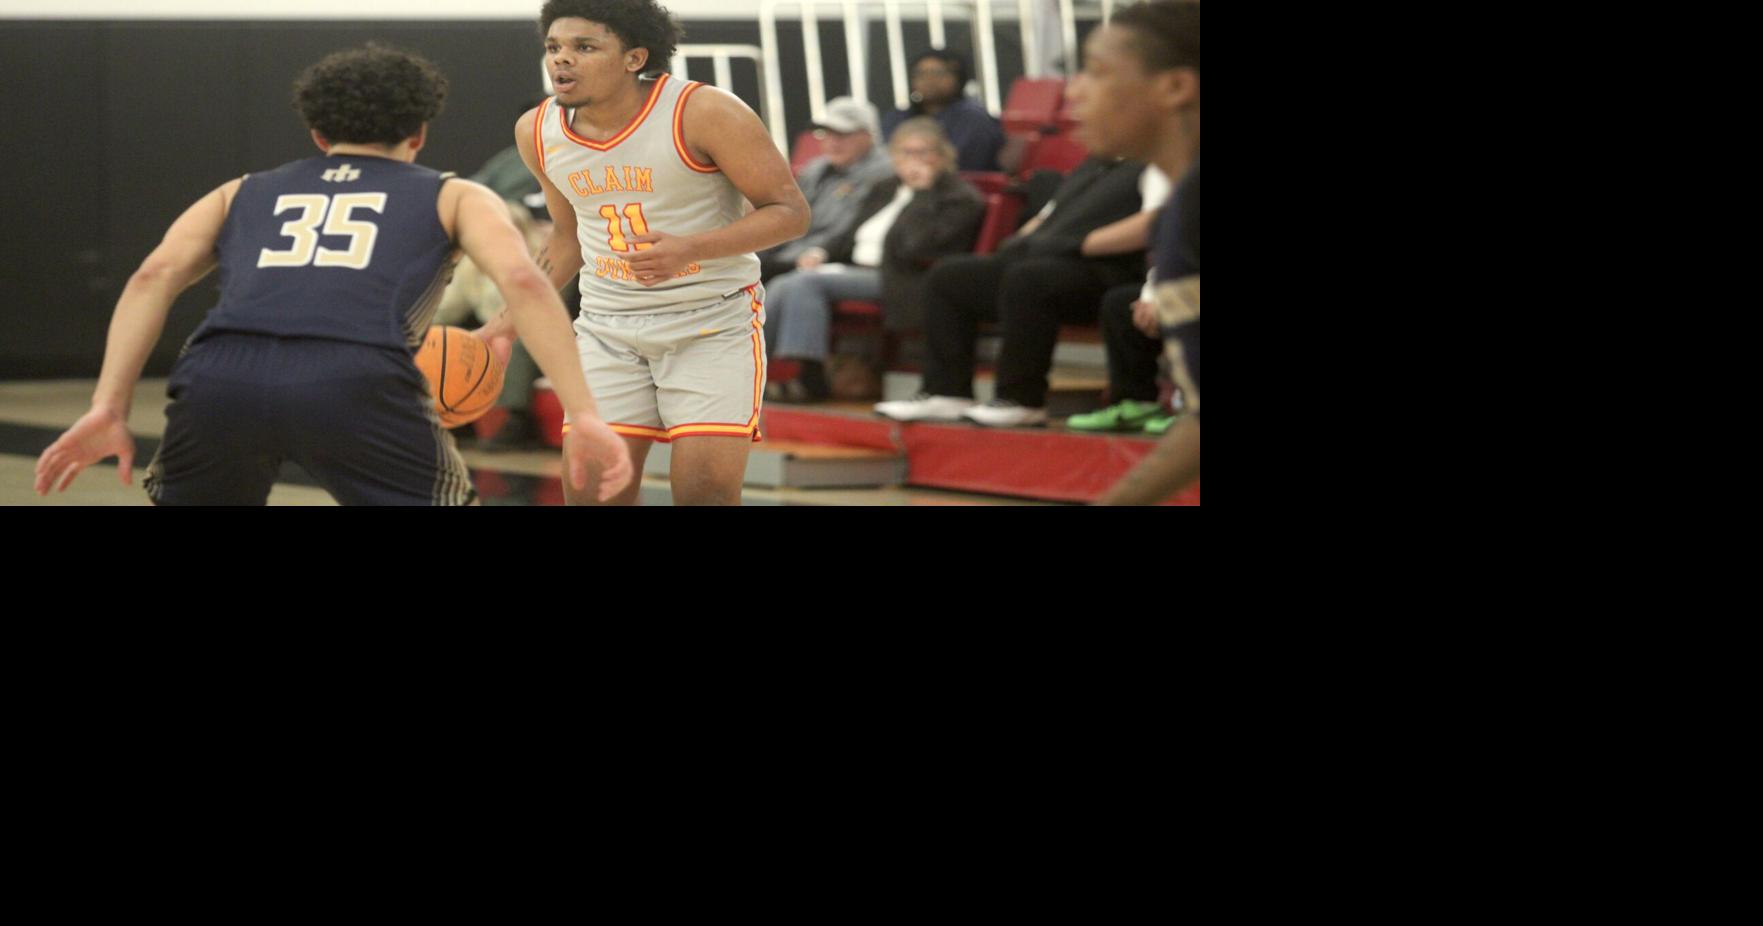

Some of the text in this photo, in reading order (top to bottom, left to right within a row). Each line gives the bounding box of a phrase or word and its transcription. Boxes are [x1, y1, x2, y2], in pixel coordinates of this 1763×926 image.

[568, 165, 653, 197] CLAIM
[257, 192, 387, 270] 35
[599, 202, 654, 252] 11
